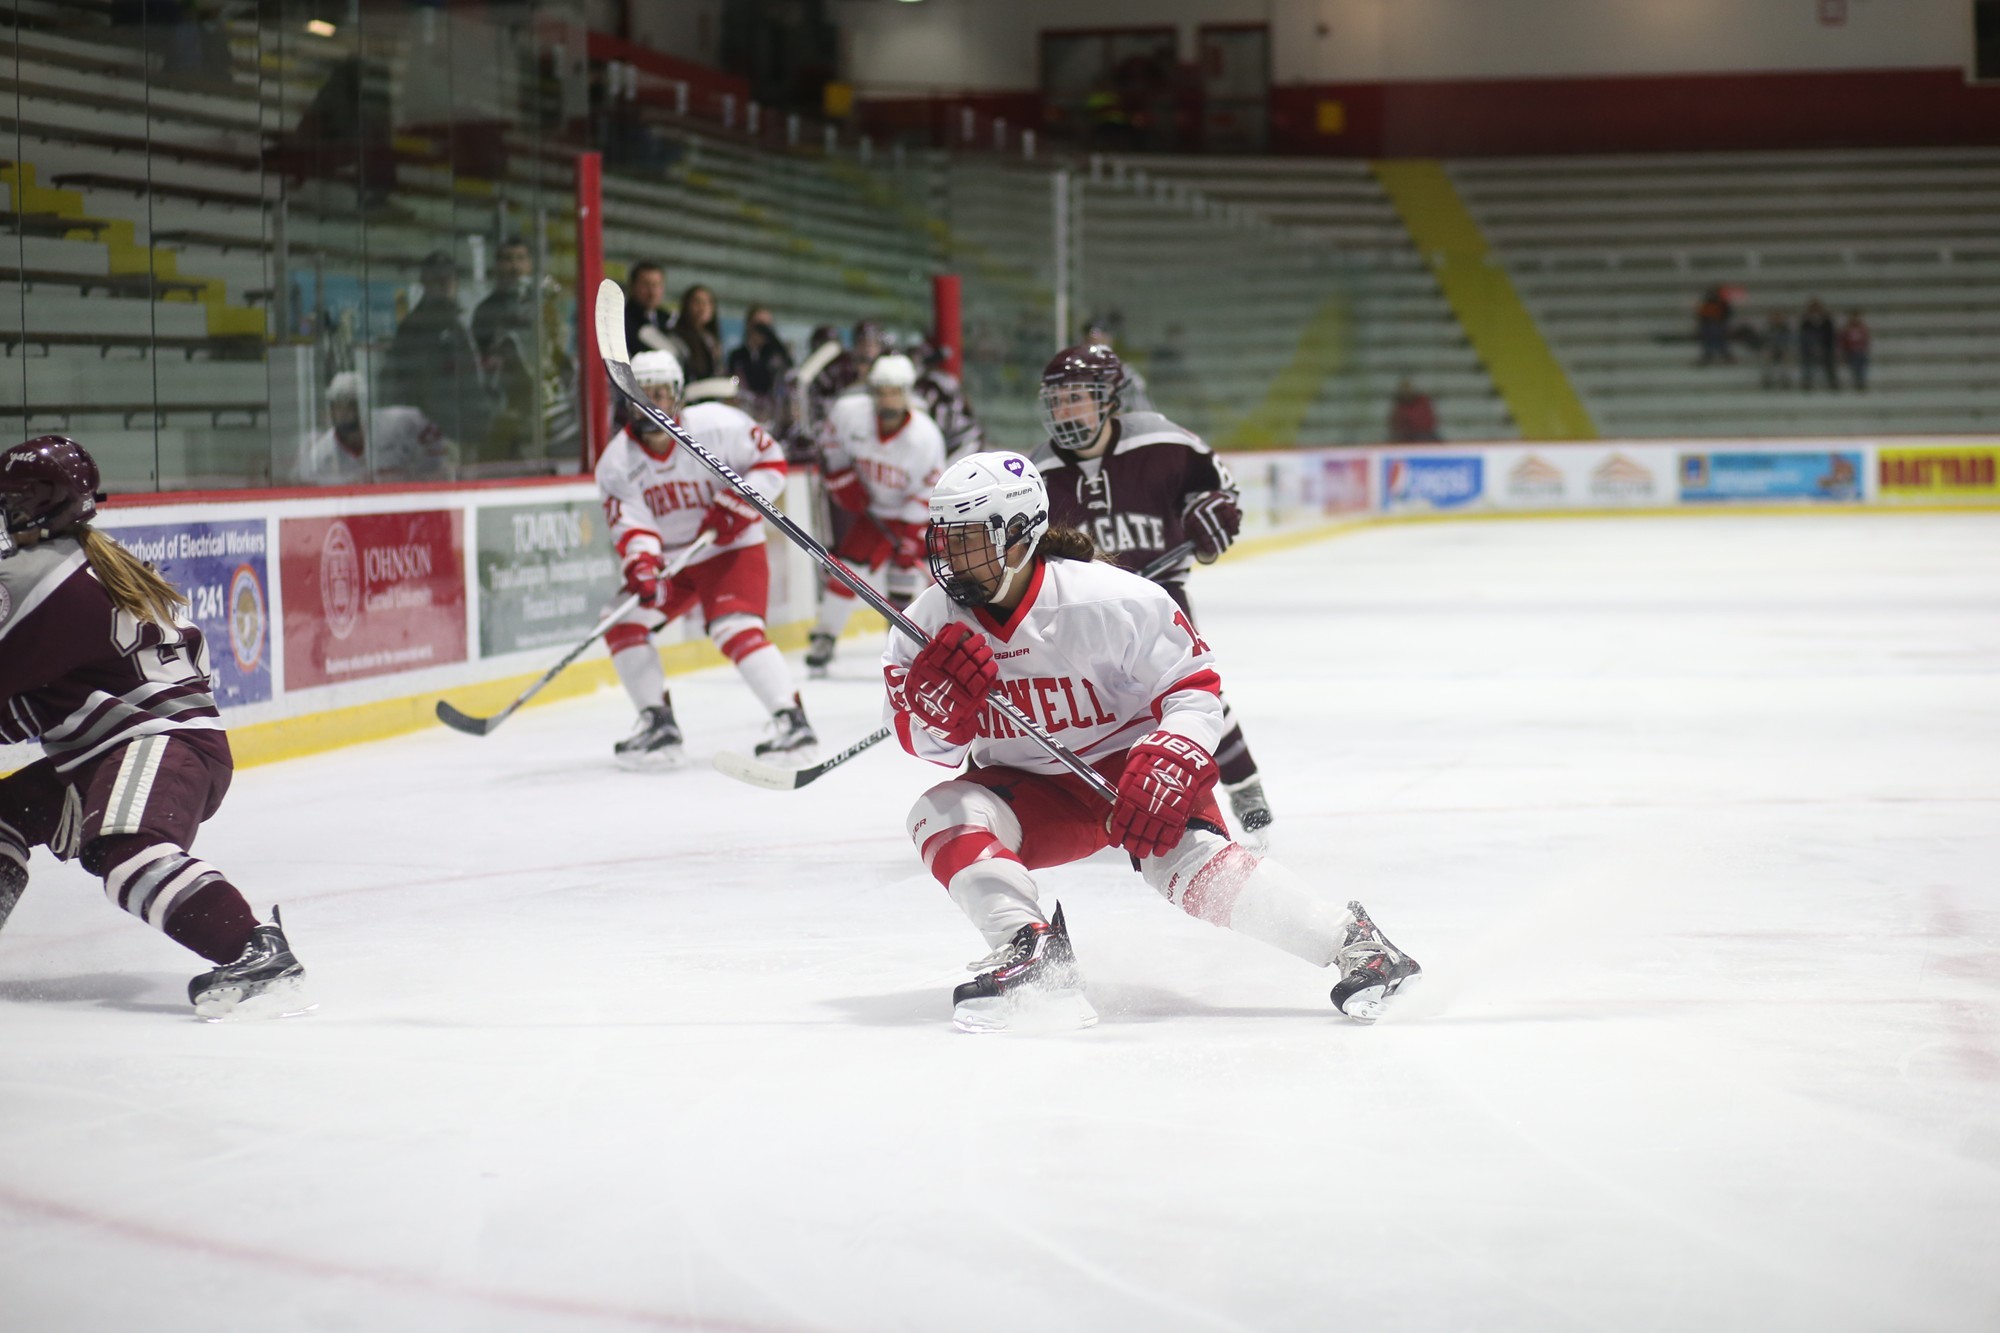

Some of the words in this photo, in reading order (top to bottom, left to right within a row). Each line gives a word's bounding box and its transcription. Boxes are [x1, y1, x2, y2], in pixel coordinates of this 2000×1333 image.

[653, 408, 757, 496] SUPREME
[167, 534, 178, 559] of
[180, 531, 226, 558] Electrical
[226, 529, 265, 553] Workers
[1094, 512, 1165, 553] GATE
[364, 543, 433, 586] JOHNSON
[197, 584, 224, 620] 241
[994, 647, 1030, 660] BAUER
[977, 676, 1116, 739] ORNELL
[995, 694, 1064, 749] BAUER
